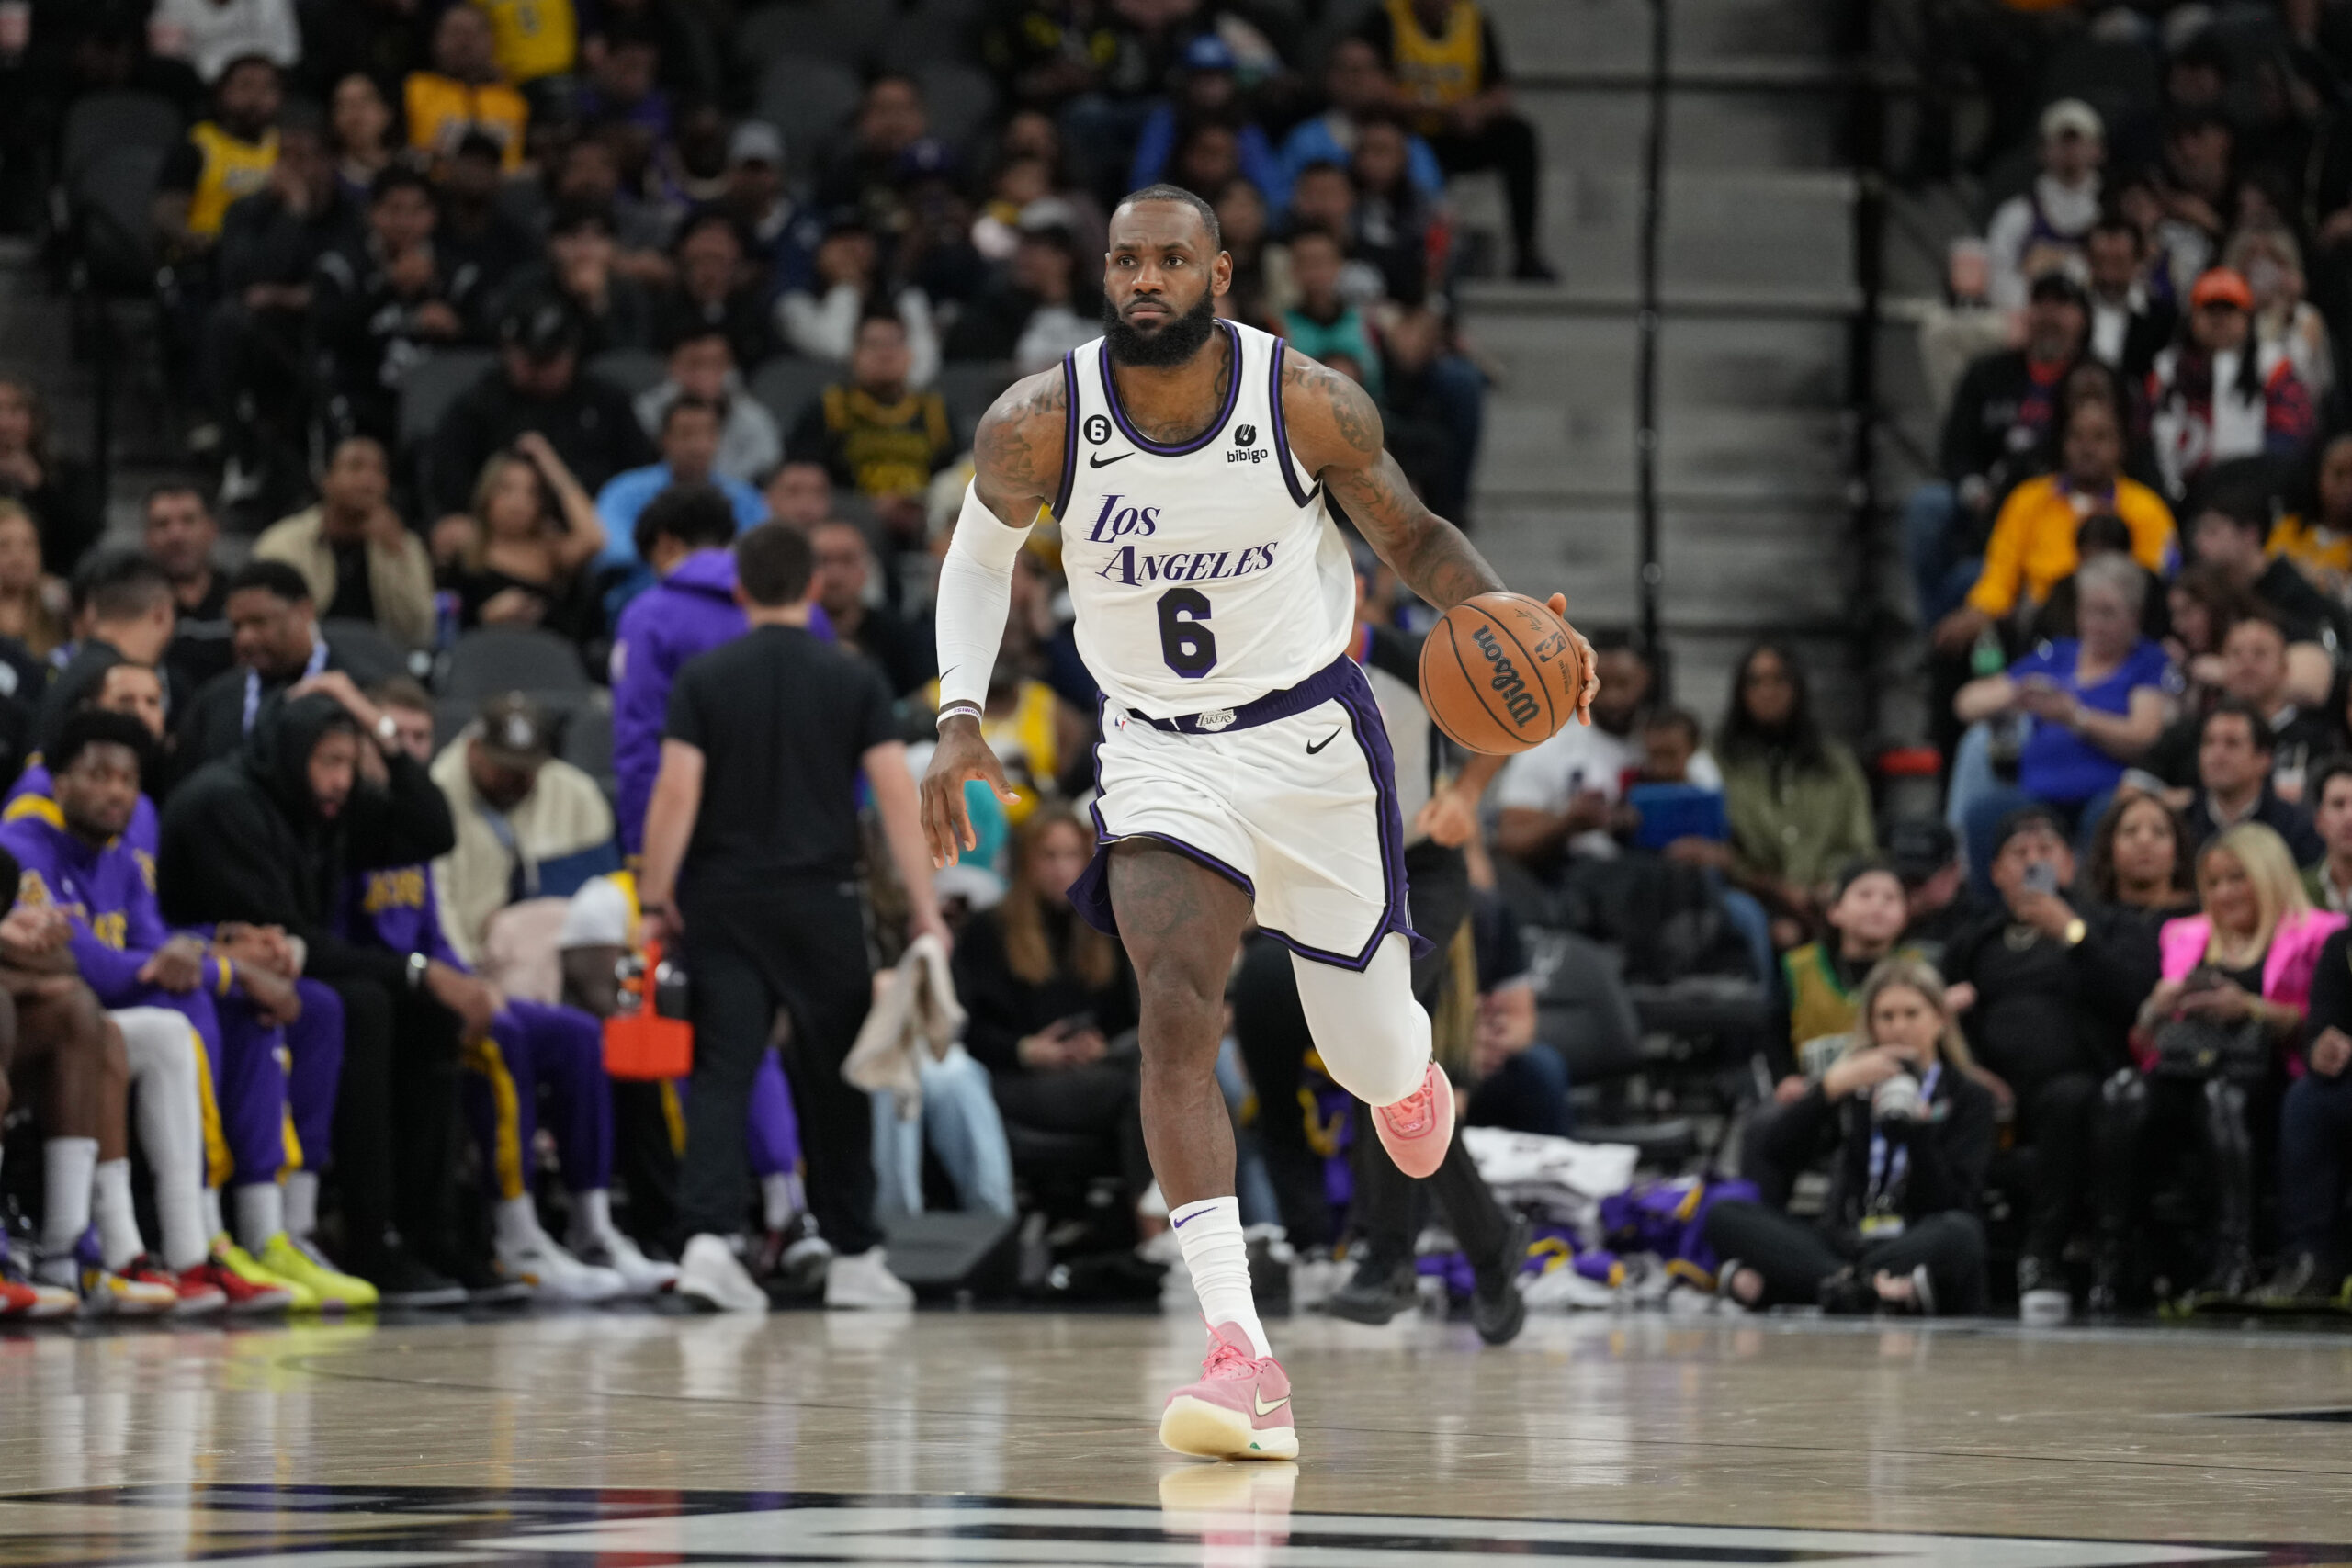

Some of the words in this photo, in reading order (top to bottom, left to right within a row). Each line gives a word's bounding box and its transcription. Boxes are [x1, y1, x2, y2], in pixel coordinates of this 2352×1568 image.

[1091, 419, 1106, 442] 6
[1227, 448, 1269, 464] bibigo
[1095, 541, 1279, 587] ANGELES
[1157, 588, 1217, 678] 6
[1472, 625, 1540, 728] Wilson
